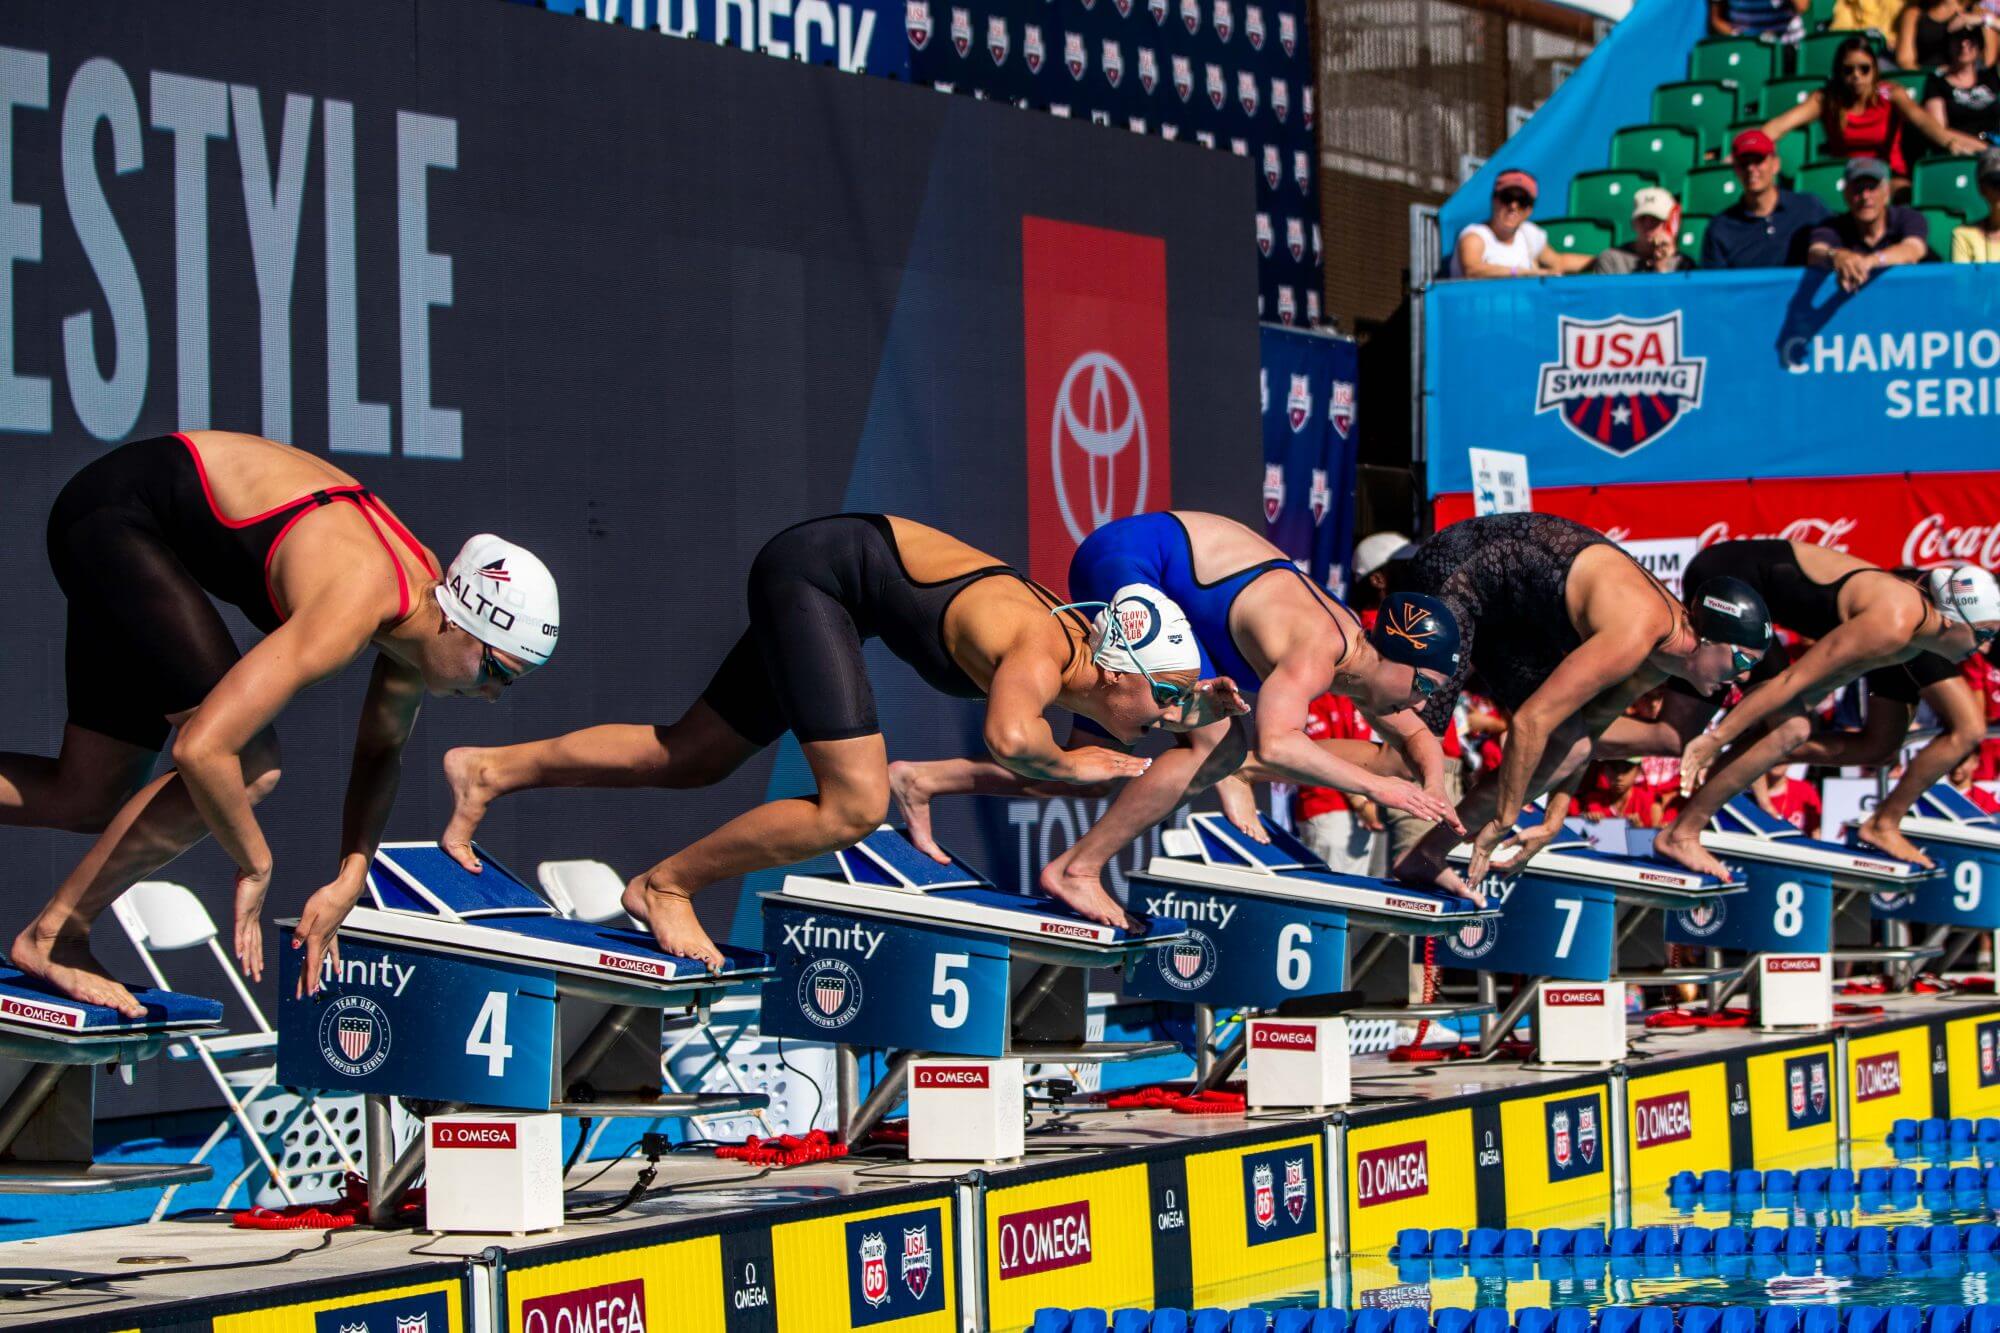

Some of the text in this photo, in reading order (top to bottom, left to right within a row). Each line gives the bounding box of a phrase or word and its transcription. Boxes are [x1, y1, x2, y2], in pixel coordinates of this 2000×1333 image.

[0, 46, 463, 458] ESTYLE
[1575, 333, 1664, 370] USA
[1551, 370, 1687, 394] SWIMMING
[1885, 377, 2000, 419] SERI
[1122, 610, 1148, 622] CLOVIS
[1125, 620, 1144, 631] SWIM
[1953, 861, 1982, 912] 9
[1146, 892, 1236, 930] xfinity
[1401, 901, 1431, 911] OMEGA
[1773, 882, 1804, 937] 8
[782, 917, 885, 960] xfinity
[1057, 925, 1092, 938] OMEGA
[1554, 899, 1583, 958] 7
[619, 959, 658, 974] OMEGA
[813, 960, 849, 974] TEAM USA
[1276, 923, 1312, 990] 6
[1781, 960, 1817, 970] OMEGA
[319, 955, 416, 997] finity
[930, 952, 970, 1029] 5
[1562, 993, 1600, 1002] OMEGA
[23, 1006, 67, 1025] OMEGA
[336, 998, 376, 1014] TEAM USA
[802, 1003, 856, 1026] CHAMPIONS SERIES
[465, 992, 513, 1077] 4
[1269, 1032, 1313, 1044] OMEGA
[324, 1047, 384, 1074] CHAMPIONS SERIES
[936, 1071, 984, 1084] OMEGA
[1865, 1060, 1900, 1094] OMEGA
[1650, 1106, 1692, 1138] OMEGA
[457, 1129, 511, 1143] OMEGA
[1480, 1150, 1501, 1167] OMEGA
[1287, 1167, 1301, 1185] USA
[1375, 1150, 1428, 1196] OMEGA
[1257, 1191, 1271, 1216] 66
[1158, 1209, 1185, 1231] OMEGA
[906, 1235, 924, 1257] USA
[1023, 1212, 1091, 1265] OMEGA
[866, 1263, 883, 1292] 66
[735, 1286, 769, 1309] OMEGA
[555, 1292, 645, 1333] OMEGA
